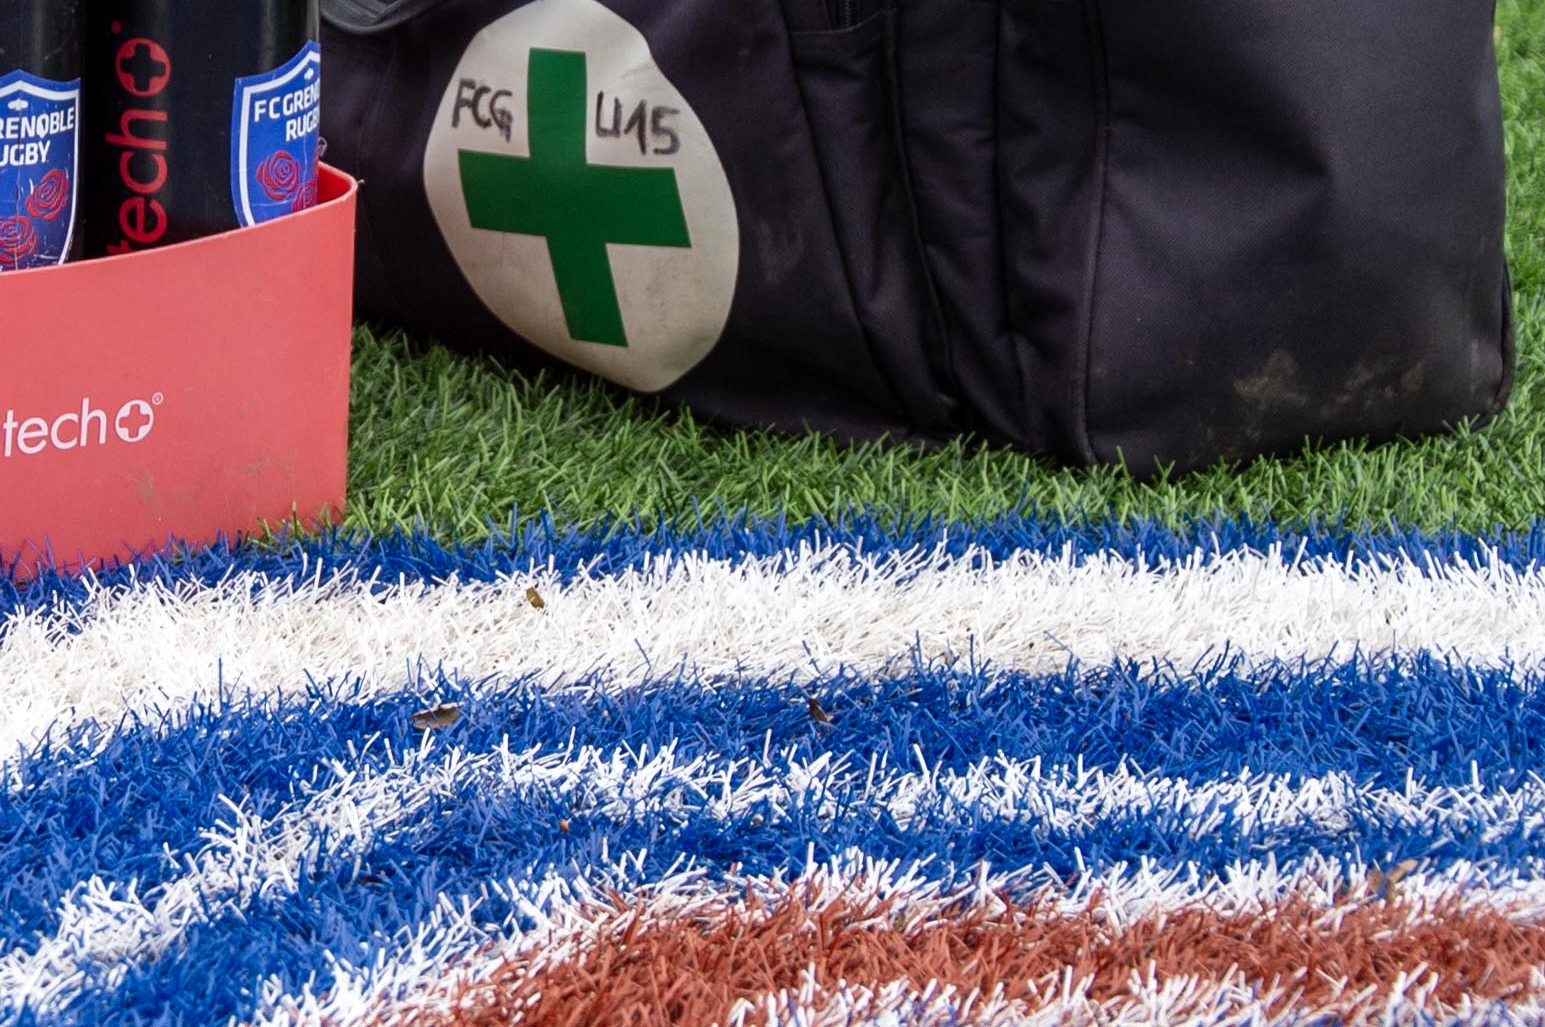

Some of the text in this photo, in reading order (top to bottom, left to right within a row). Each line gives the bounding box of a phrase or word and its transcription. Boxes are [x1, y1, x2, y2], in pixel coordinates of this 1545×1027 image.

[254, 96, 281, 123] FC
[451, 77, 514, 142] FCG
[595, 90, 681, 156] U15
